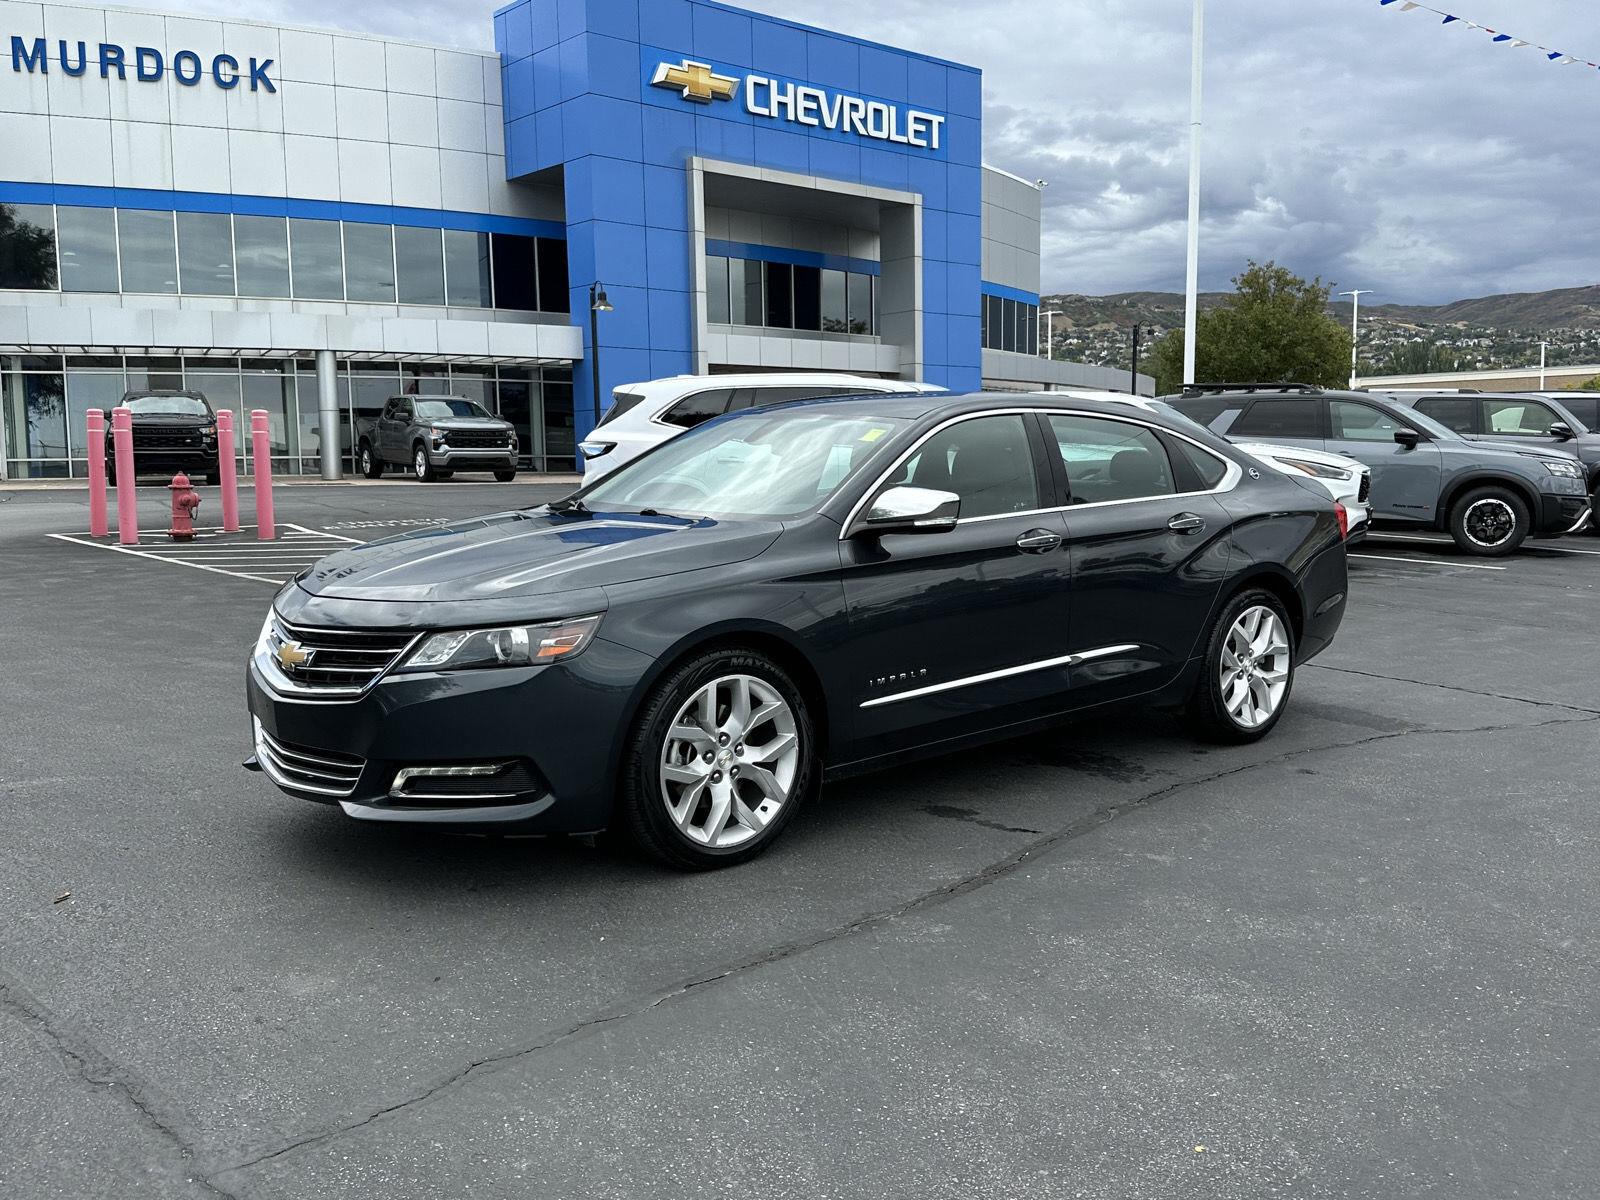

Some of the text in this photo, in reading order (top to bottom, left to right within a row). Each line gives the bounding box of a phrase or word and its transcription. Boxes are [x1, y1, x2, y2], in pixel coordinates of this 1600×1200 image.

[11, 36, 276, 93] MURDOCK
[745, 74, 945, 149] CHEVROLET
[869, 668, 927, 687] IMPALA
